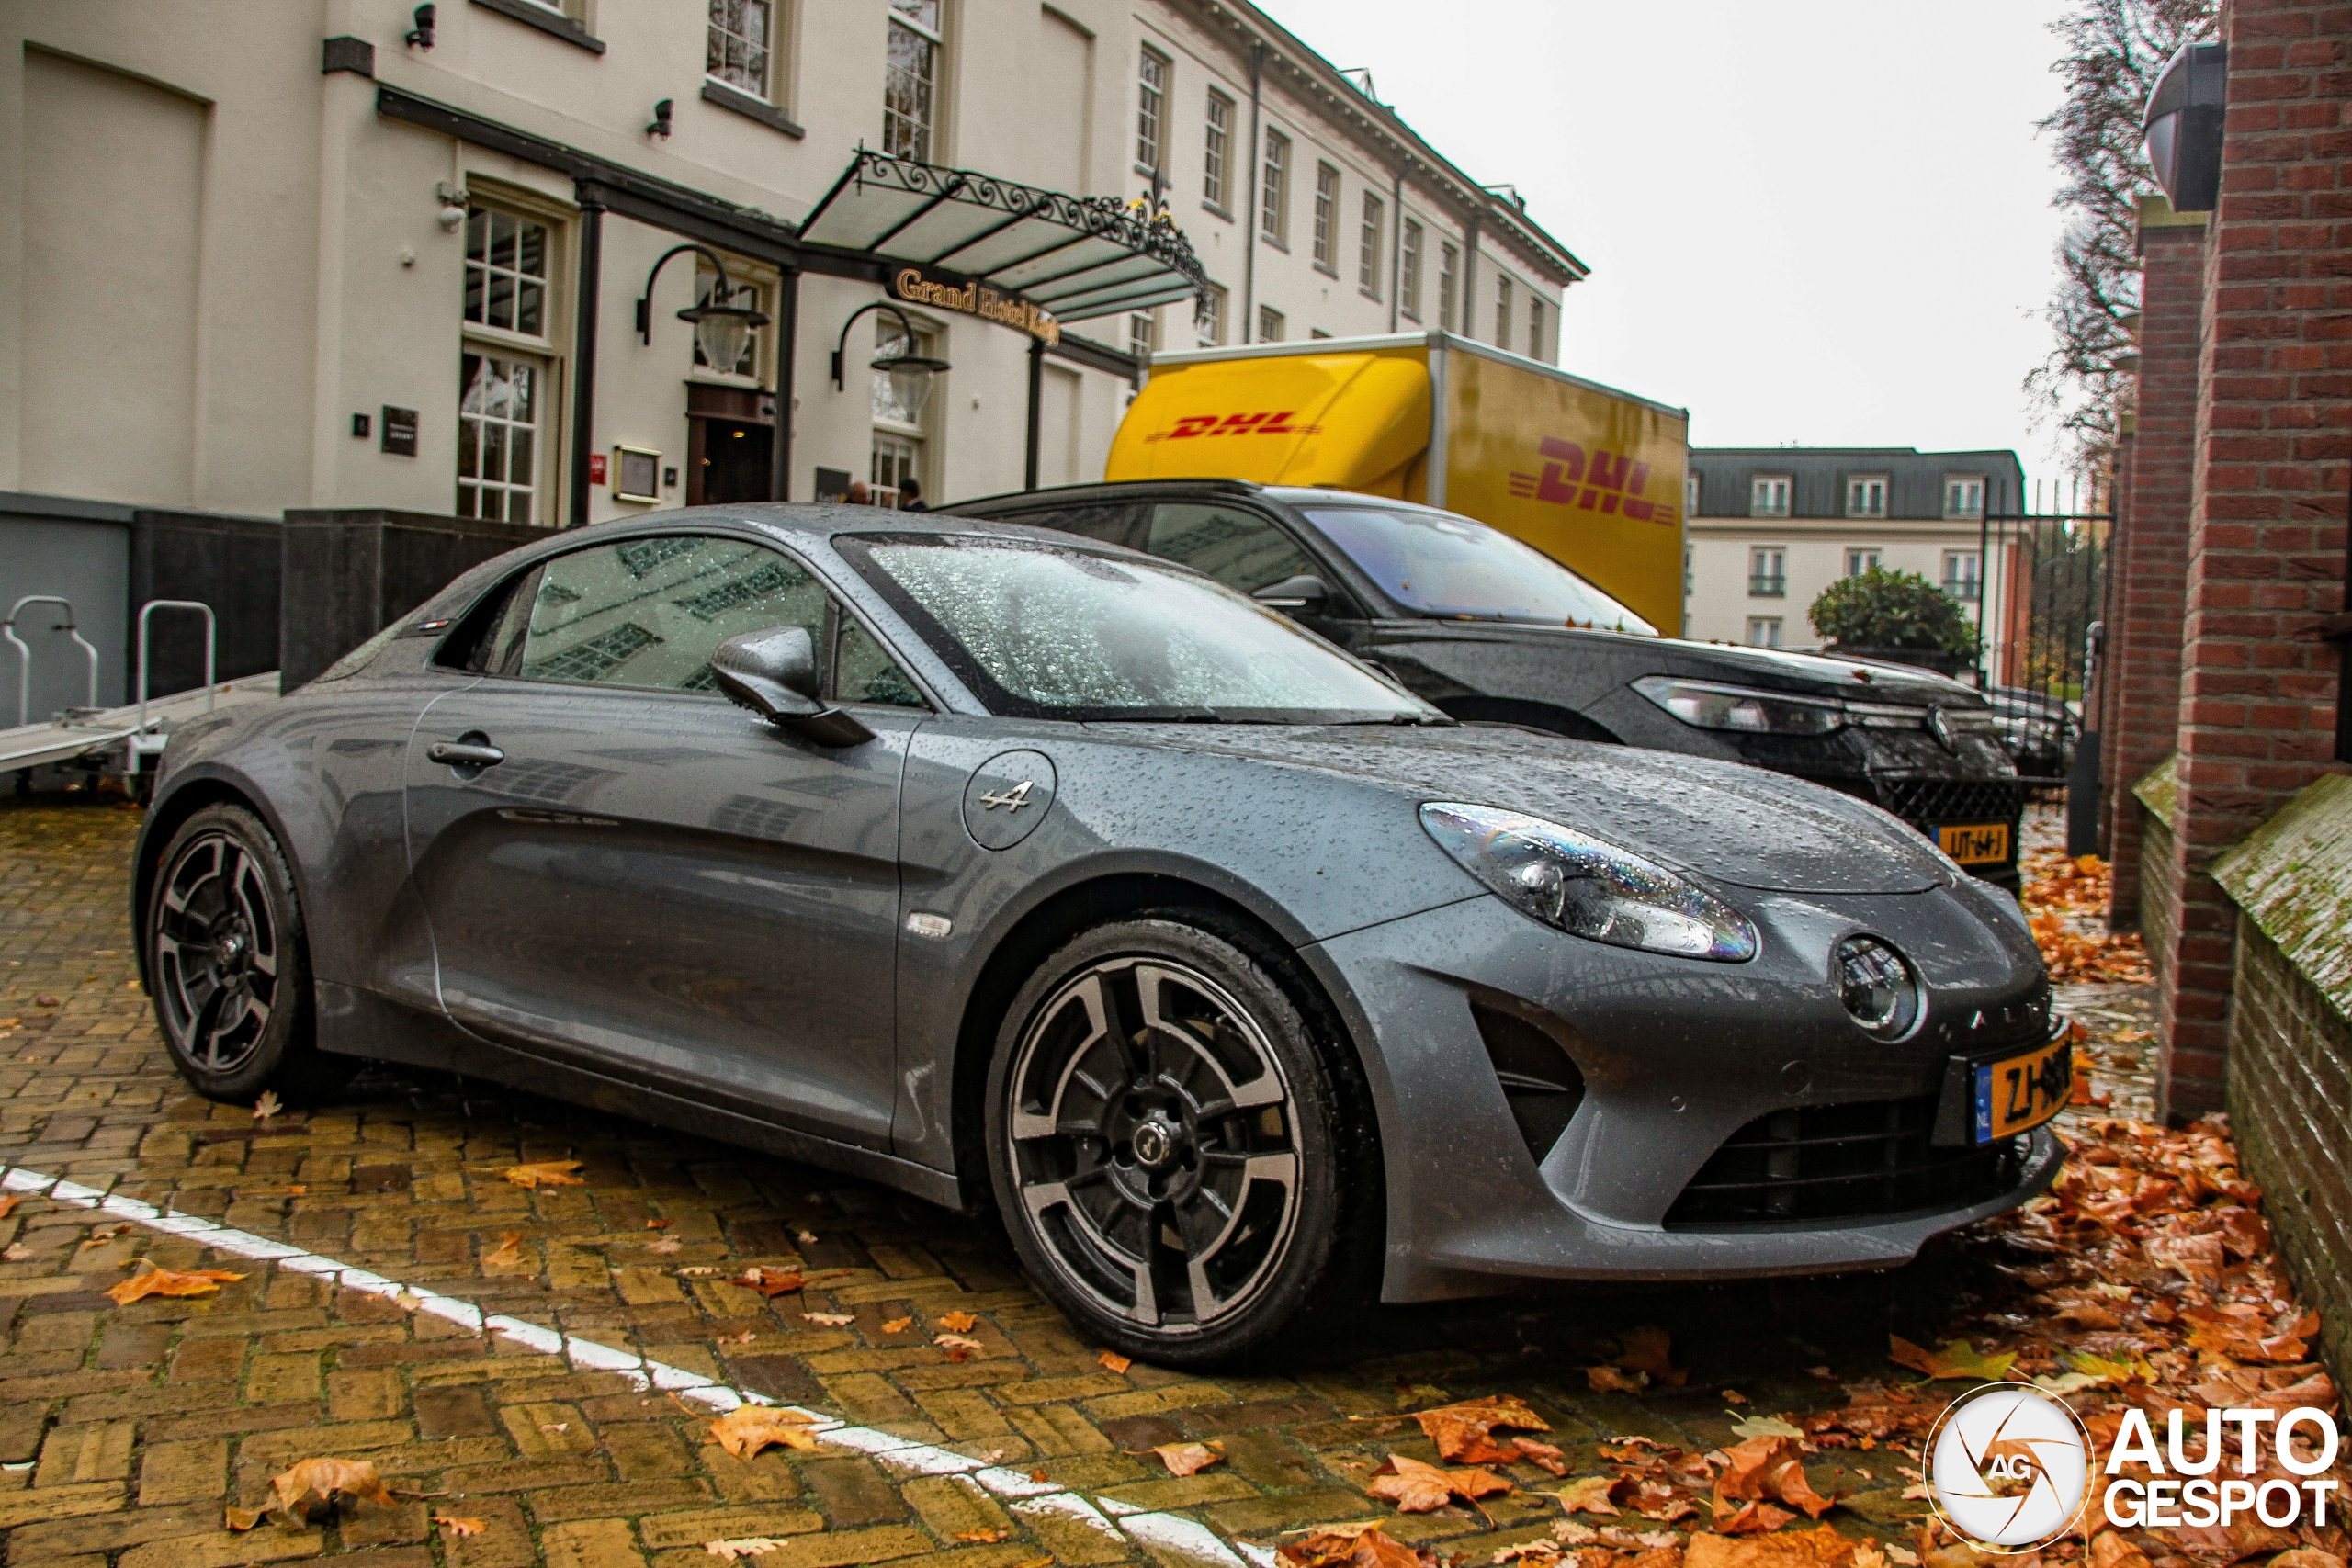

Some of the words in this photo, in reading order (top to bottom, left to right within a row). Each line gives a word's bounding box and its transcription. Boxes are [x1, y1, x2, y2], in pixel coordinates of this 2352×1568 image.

[896, 268, 977, 313] Grand
[978, 286, 1028, 327] Hotel
[1167, 412, 1294, 439] DHL
[1536, 435, 1654, 522] DHL
